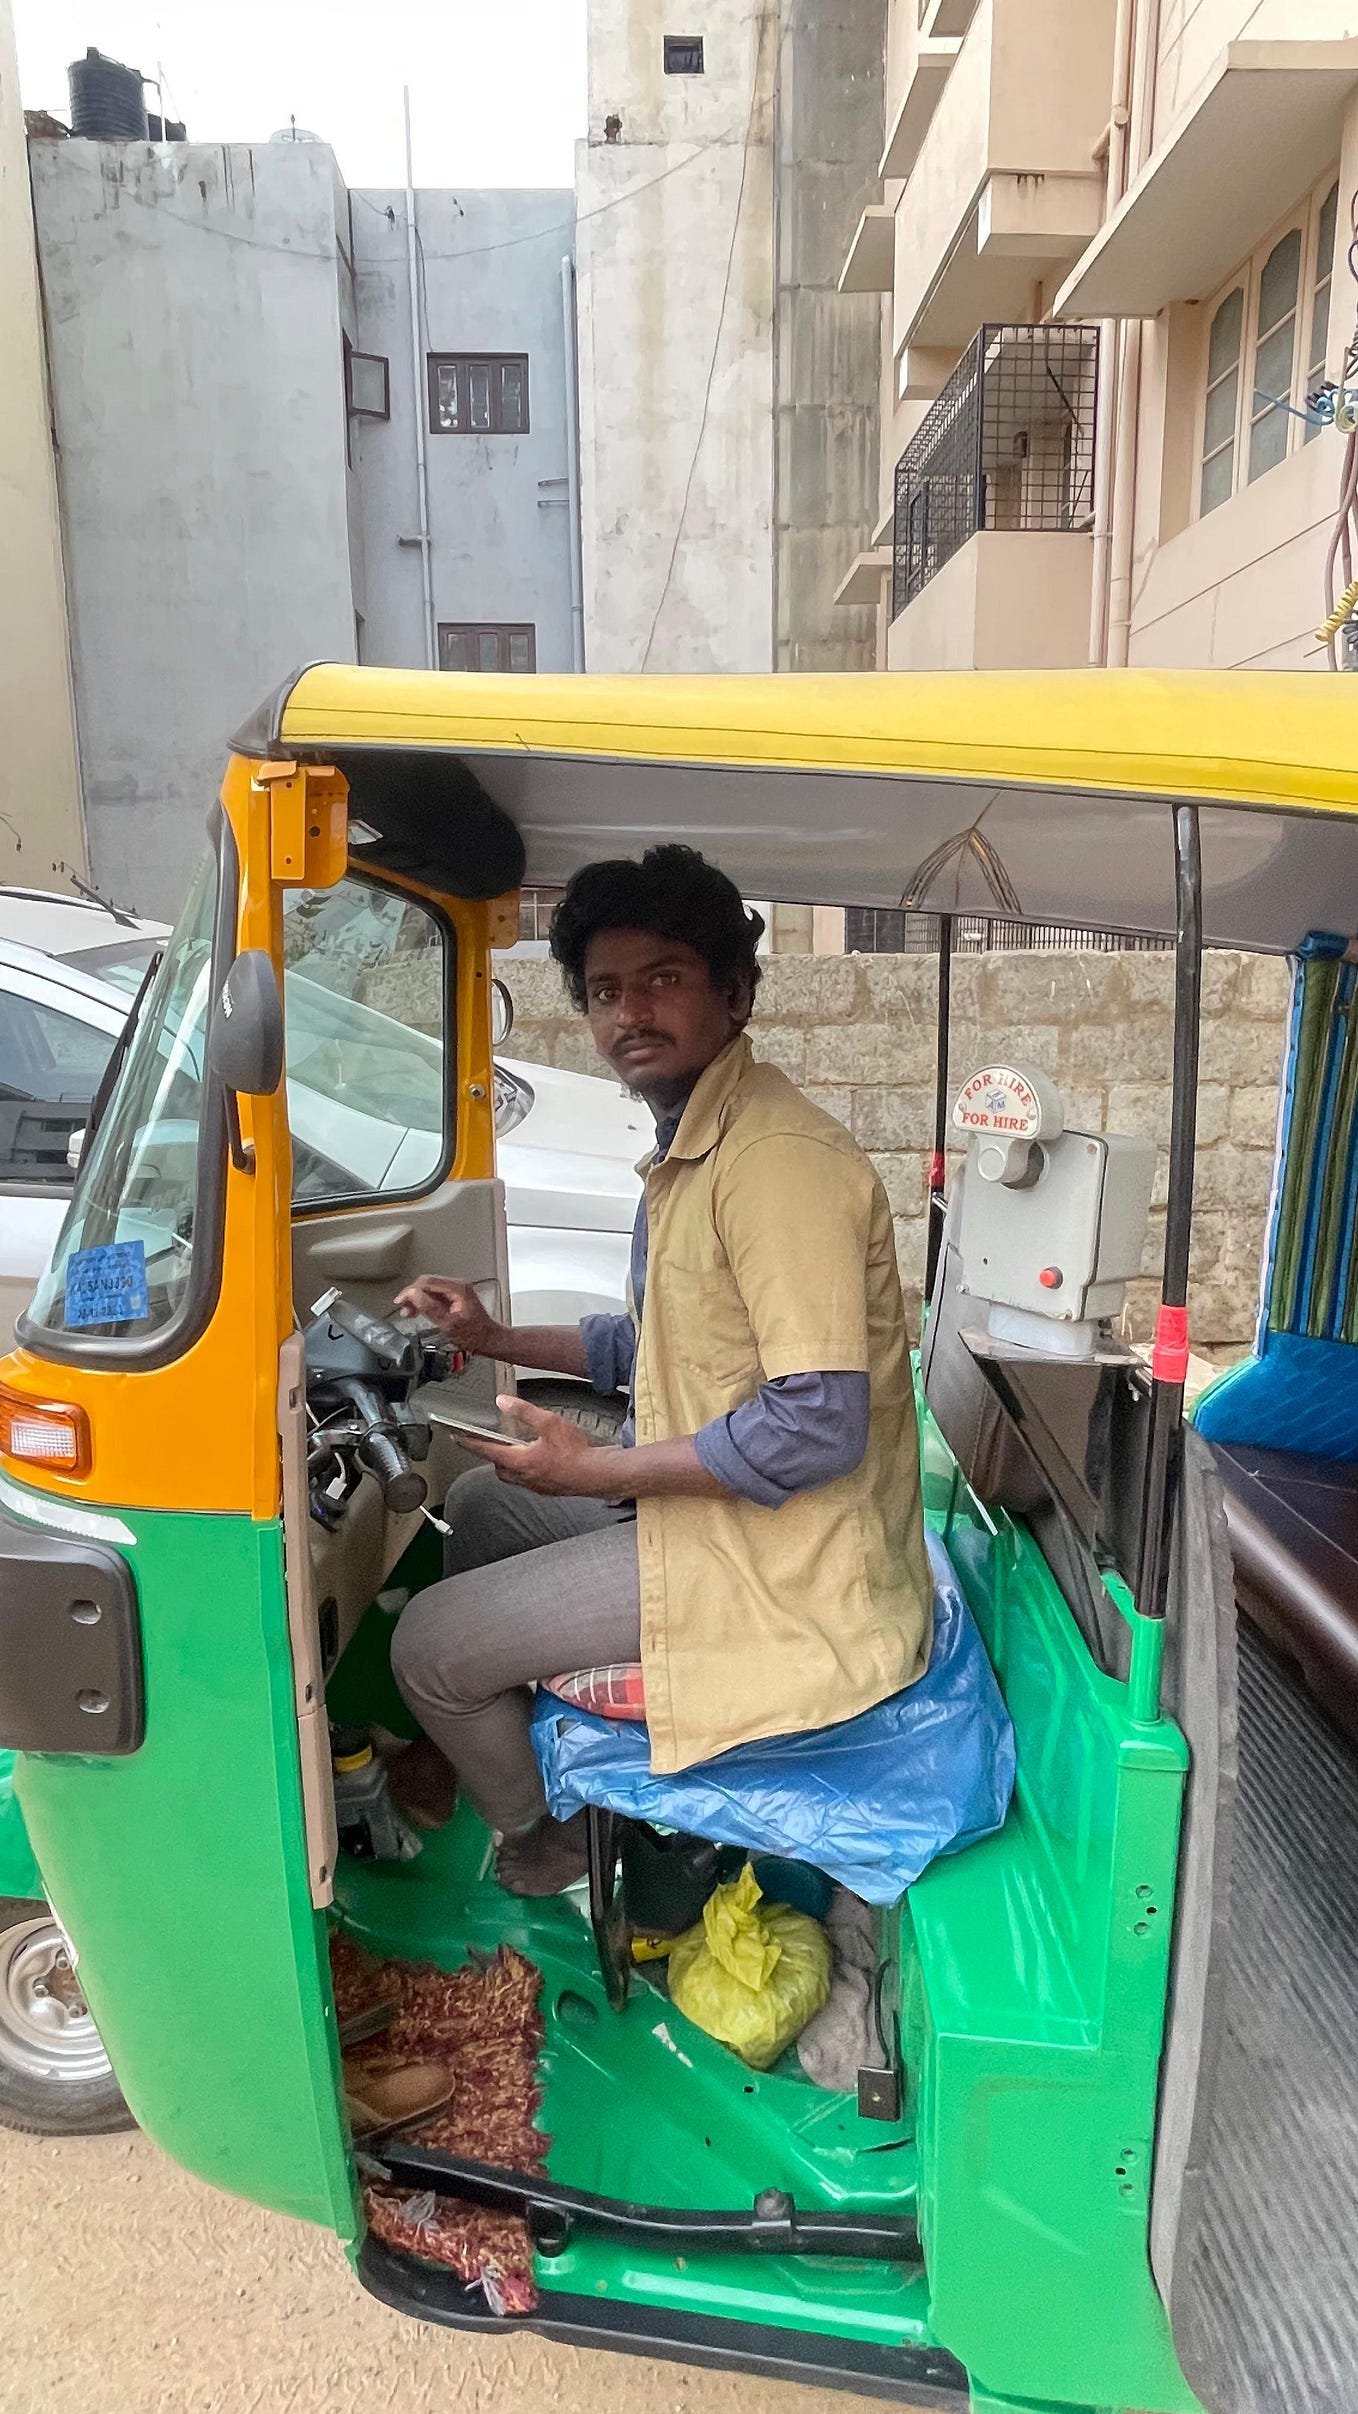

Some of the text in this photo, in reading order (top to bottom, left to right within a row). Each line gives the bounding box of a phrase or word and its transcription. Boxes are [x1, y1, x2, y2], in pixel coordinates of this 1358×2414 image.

[965, 1073, 1031, 1106] FOR HIRE
[962, 1113, 1028, 1131] FOR HIRE
